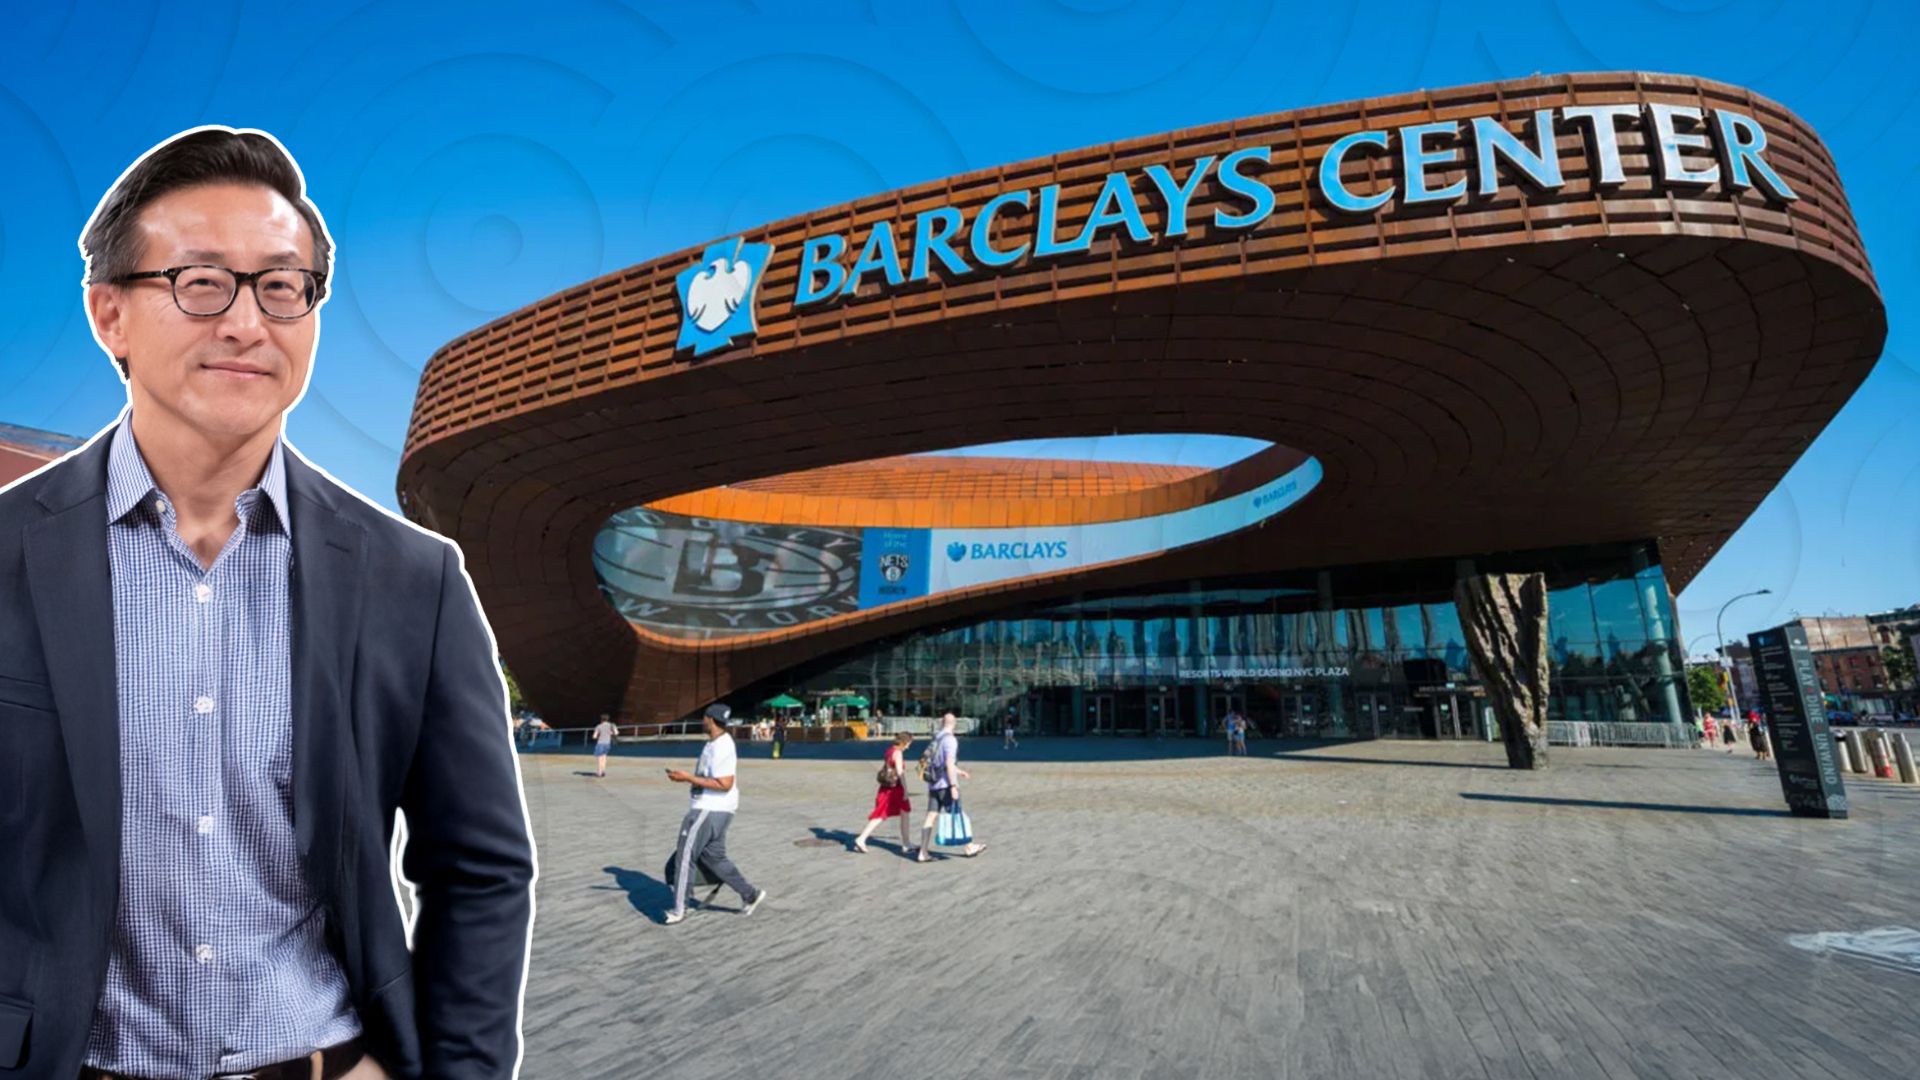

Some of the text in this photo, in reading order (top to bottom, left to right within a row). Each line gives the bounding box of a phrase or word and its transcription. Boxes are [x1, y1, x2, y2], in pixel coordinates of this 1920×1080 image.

[794, 101, 1800, 306] BARCLAYS CENTER
[970, 541, 1067, 560] BARCLAYS
[879, 554, 909, 568] NETS
[1179, 667, 1350, 679] RESORTS WORLD CASINO NYC PLAZA
[1797, 659, 1815, 687] PLAY
[1806, 694, 1824, 724] DINE
[1815, 733, 1837, 785] UNWIND
